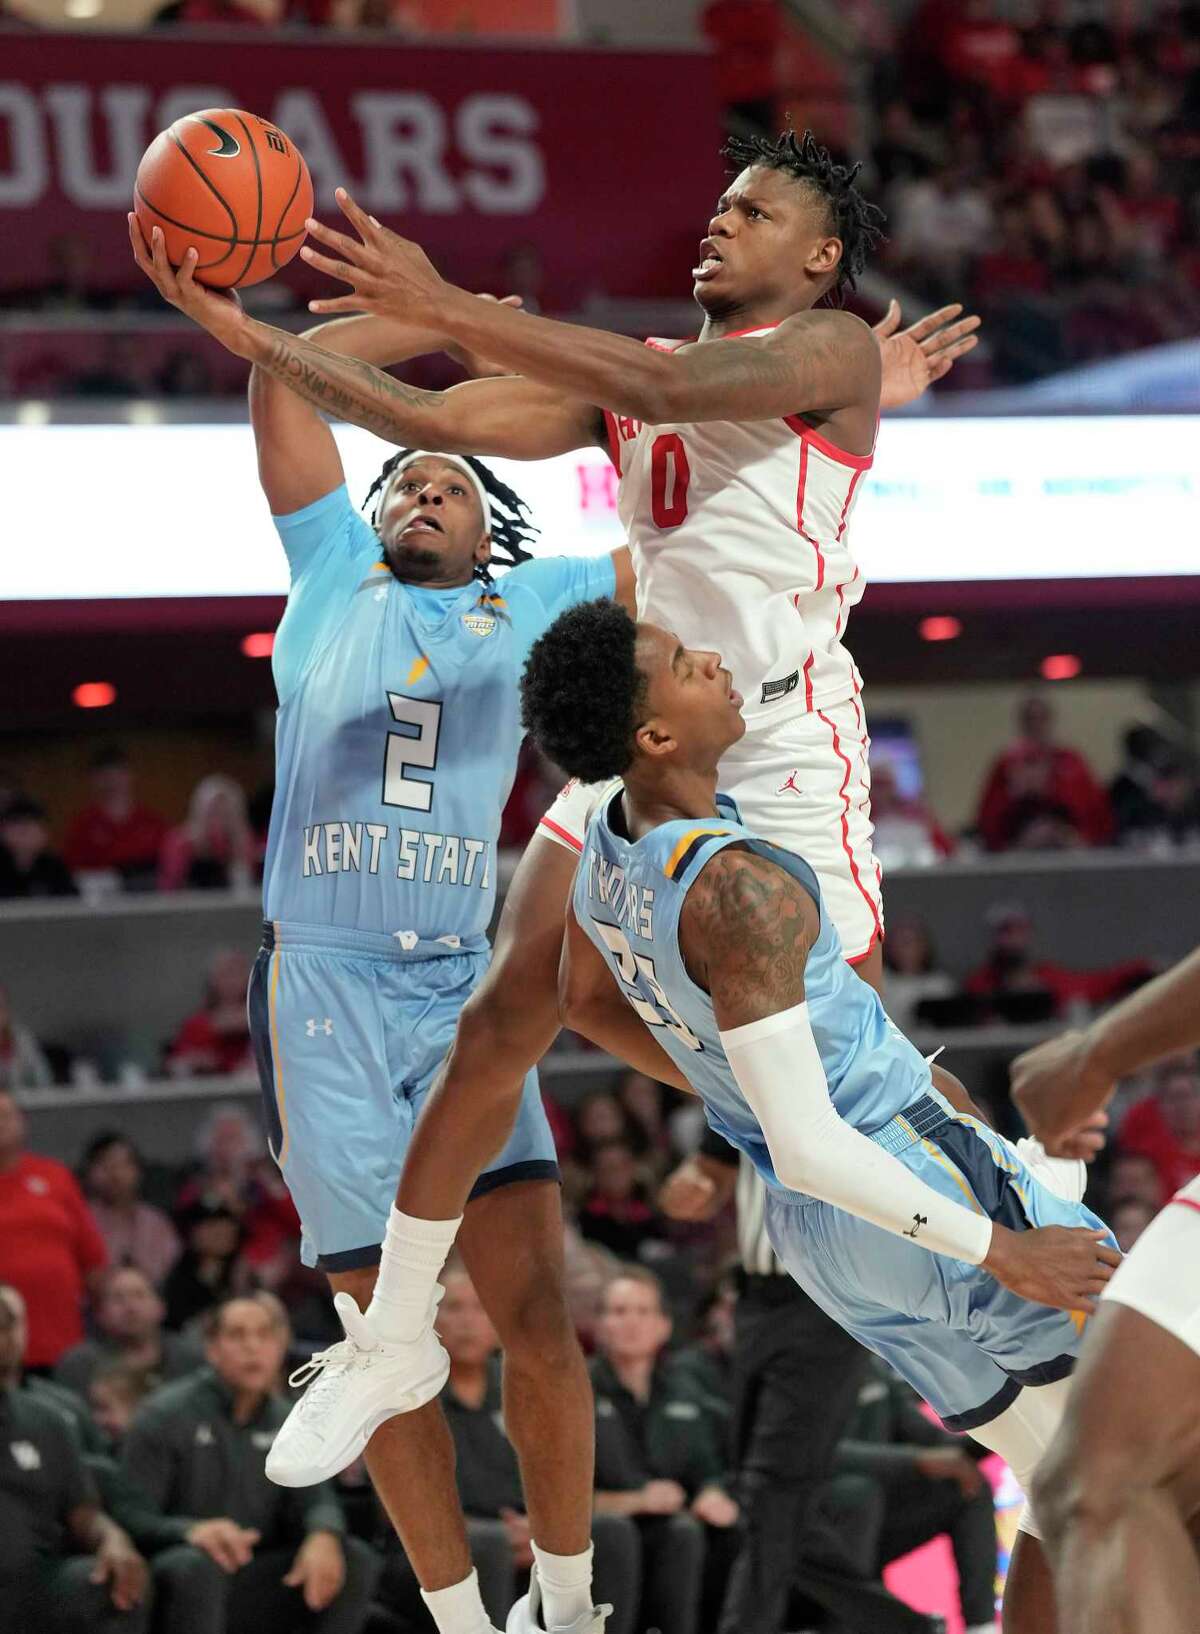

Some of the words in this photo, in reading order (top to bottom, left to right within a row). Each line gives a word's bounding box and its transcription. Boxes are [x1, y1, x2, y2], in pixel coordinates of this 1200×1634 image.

[651, 433, 690, 529] 0
[381, 690, 443, 813] 2
[302, 822, 388, 877] KENT
